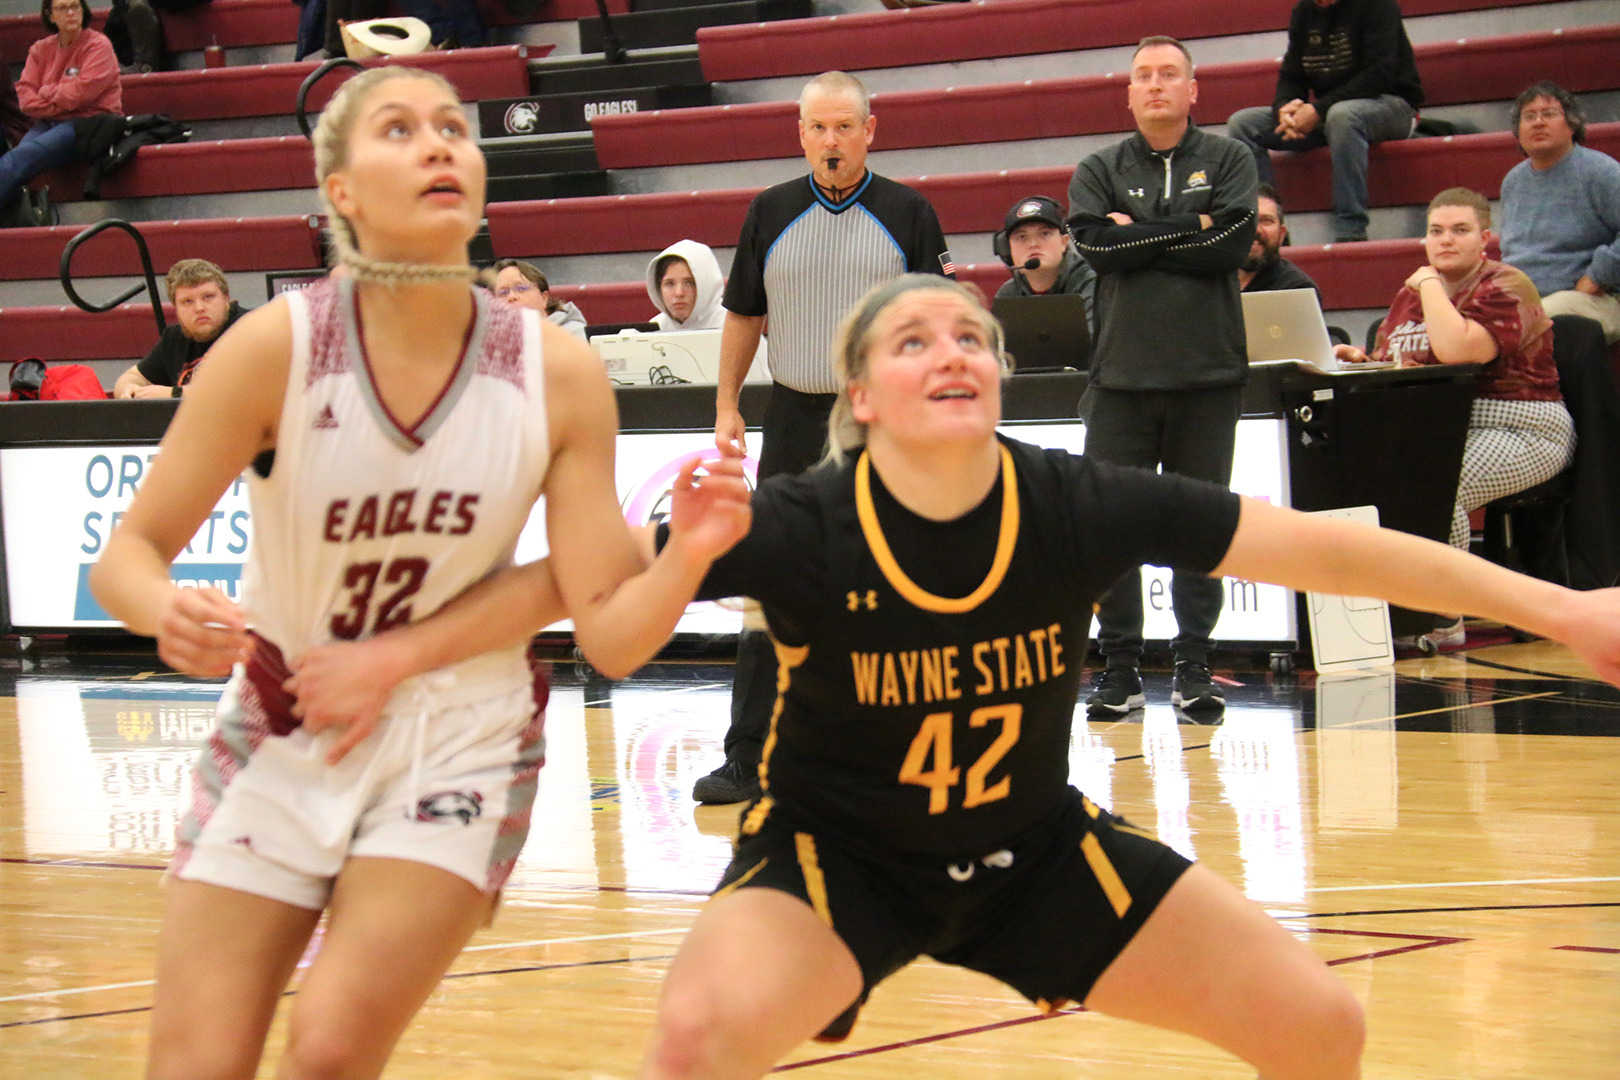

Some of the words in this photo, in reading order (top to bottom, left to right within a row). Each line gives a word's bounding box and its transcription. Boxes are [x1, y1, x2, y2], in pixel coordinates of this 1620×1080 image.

[584, 102, 597, 122] GO
[1387, 333, 1430, 355] STATE
[323, 489, 480, 543] EAGLES
[329, 557, 430, 641] 32
[851, 645, 962, 706] WAYNE
[972, 622, 1066, 696] STATE
[898, 703, 1023, 815] 42
